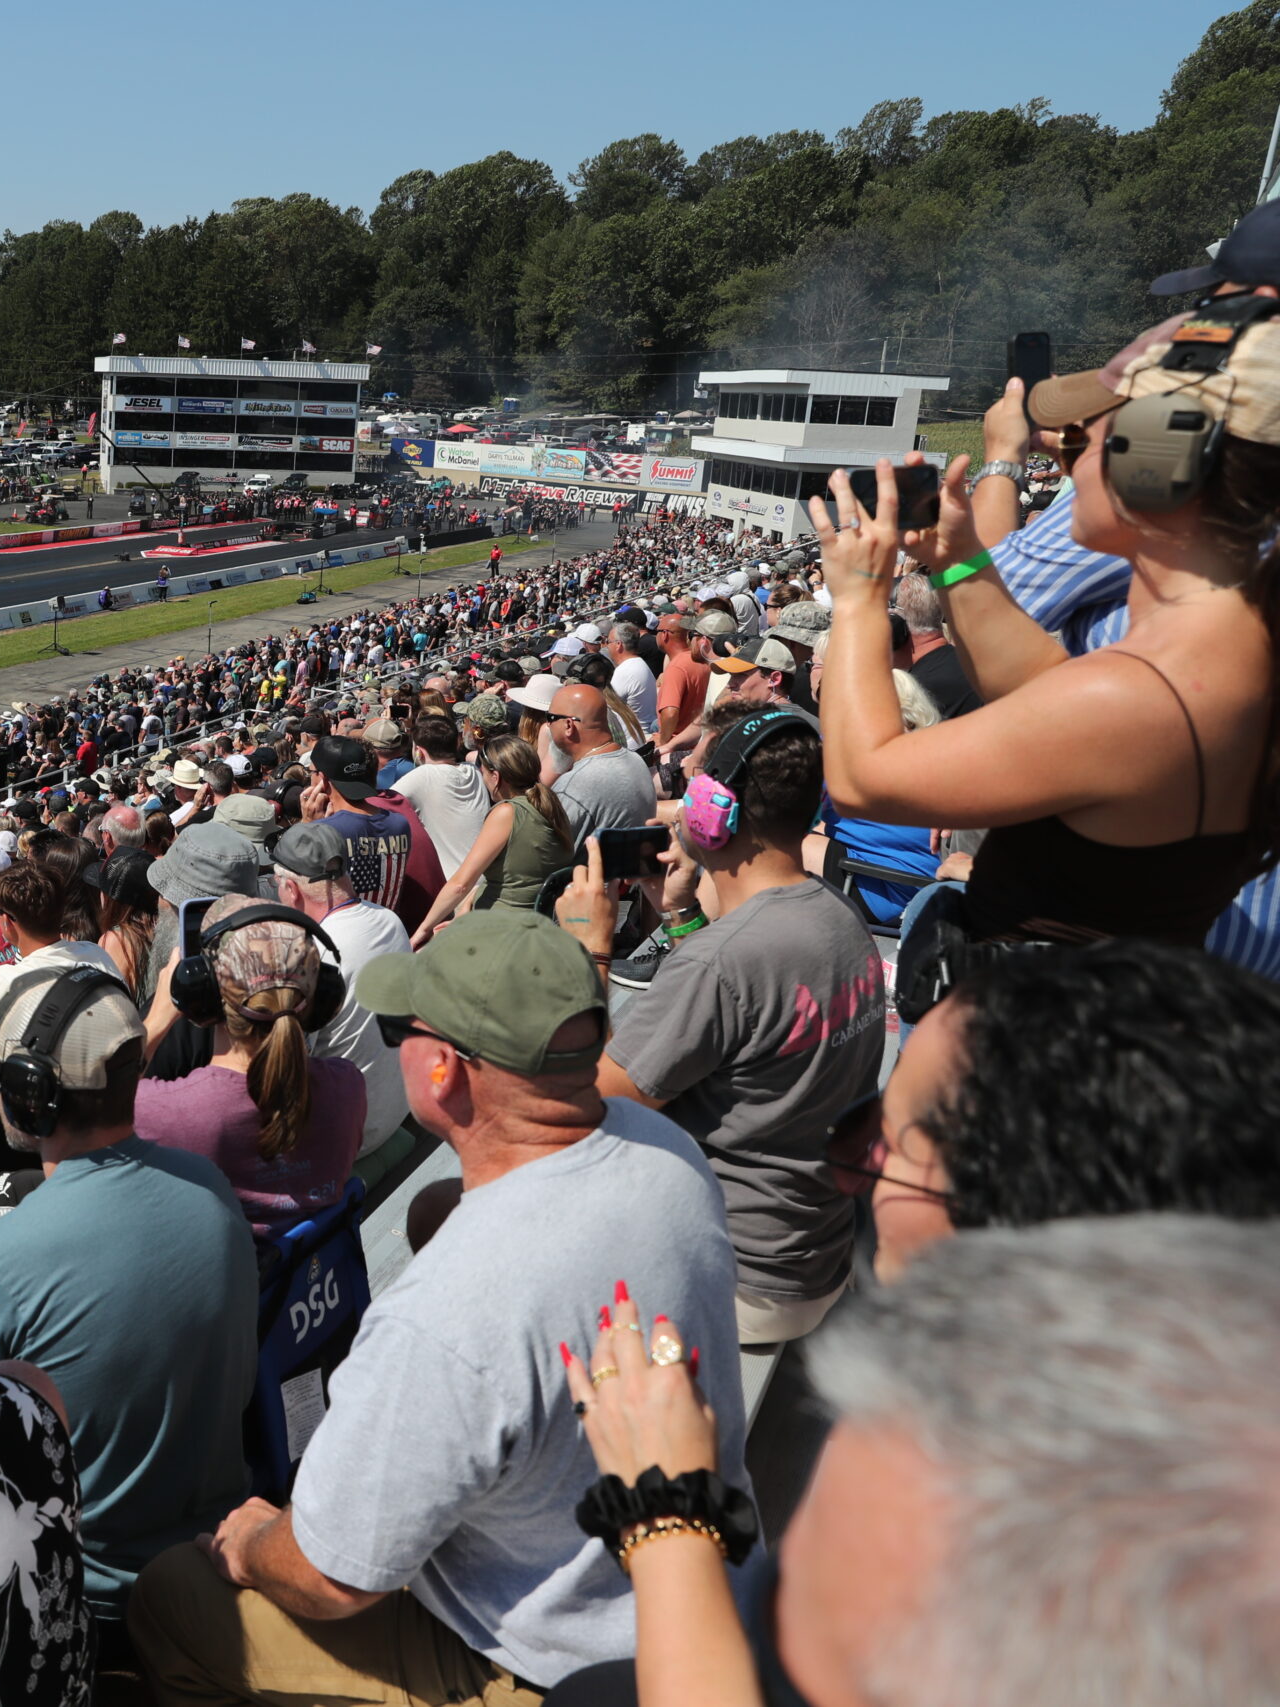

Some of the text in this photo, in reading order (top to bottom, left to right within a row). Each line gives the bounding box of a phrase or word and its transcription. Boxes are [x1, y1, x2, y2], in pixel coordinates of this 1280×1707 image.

[125, 398, 163, 408] JESEL
[322, 440, 351, 451] SCAG
[448, 447, 474, 457] Watson
[447, 455, 480, 466] McDaniel
[346, 834, 408, 857] I STAND
[289, 1267, 340, 1344] DSG
